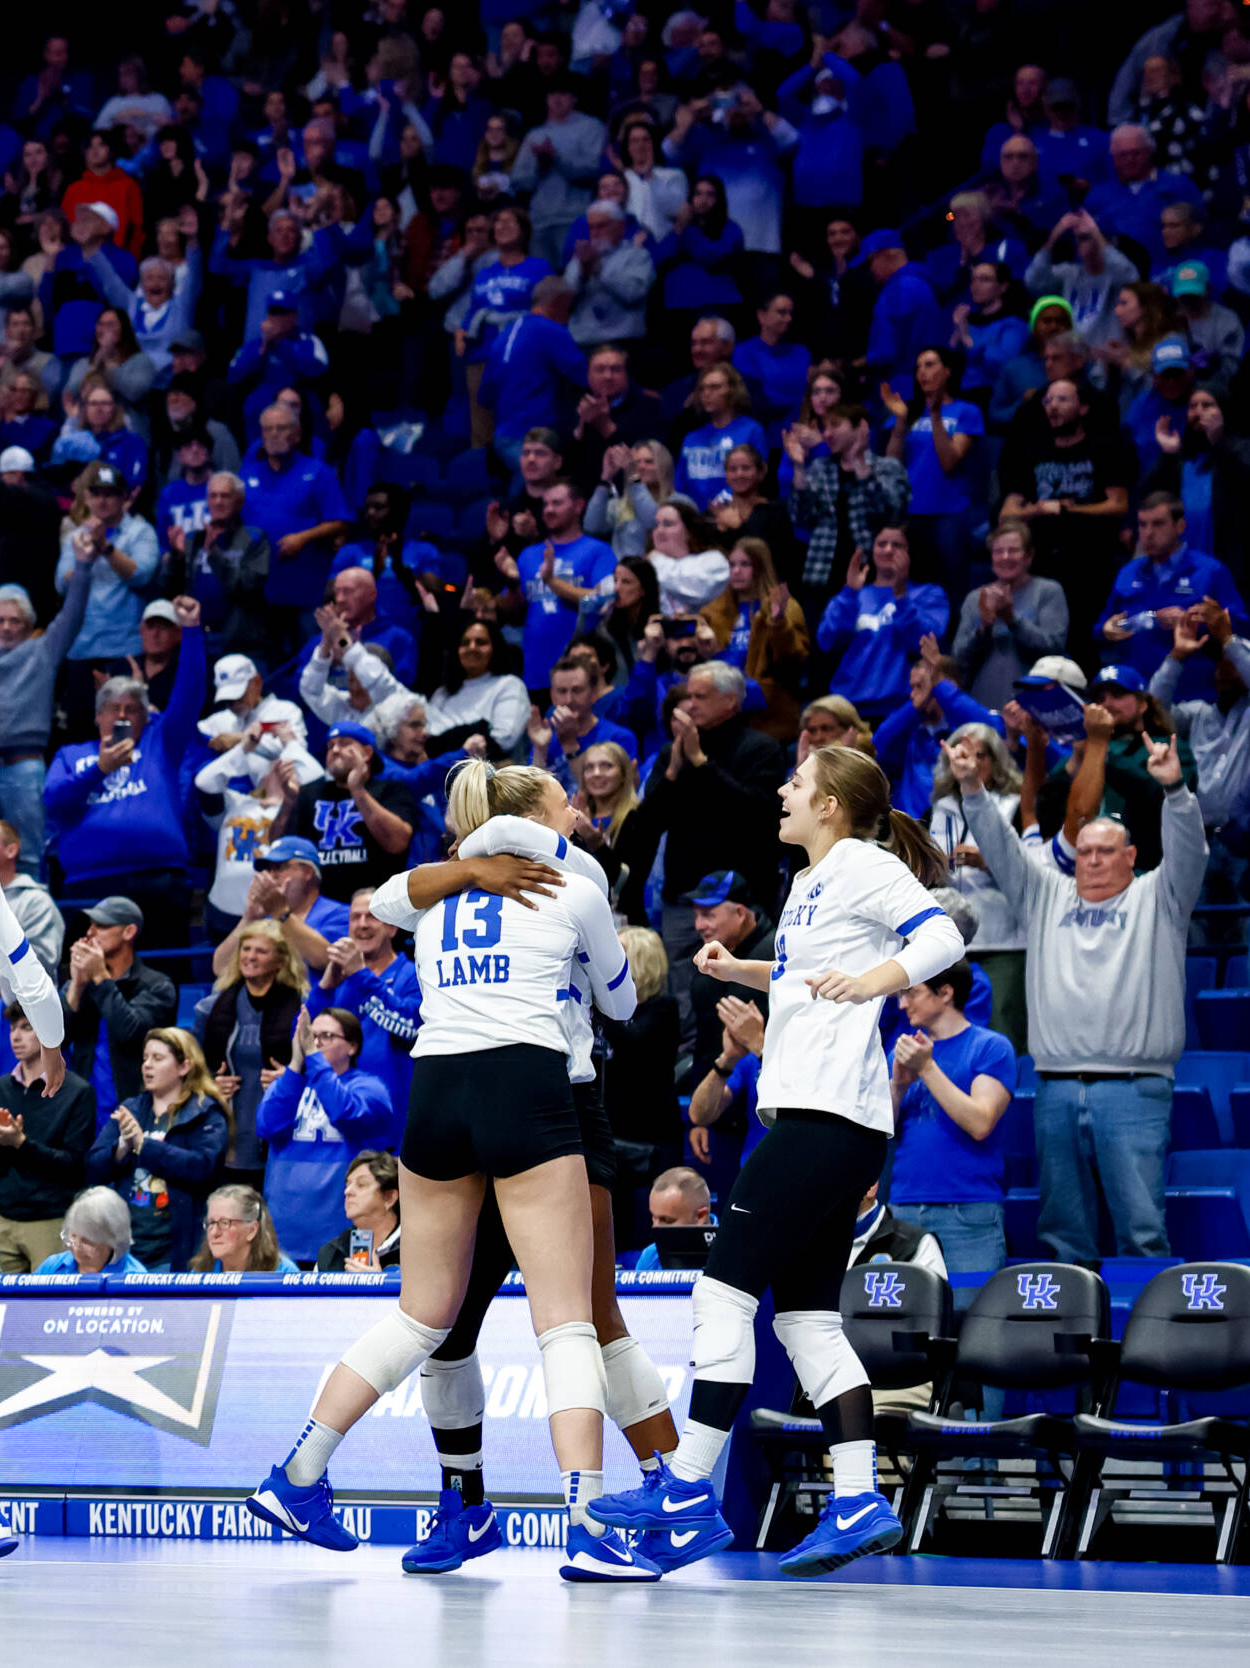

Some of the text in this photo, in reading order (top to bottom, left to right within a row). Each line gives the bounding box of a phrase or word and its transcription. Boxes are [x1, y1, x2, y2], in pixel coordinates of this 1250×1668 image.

[312, 798, 364, 849] UK
[441, 888, 504, 953] 13
[436, 954, 511, 988] LAMB
[17, 1273, 82, 1286] COMMITMENT
[124, 1273, 243, 1285] KENTUCKY FARM BUREAU
[282, 1273, 388, 1286] BIG ON COMMITMENT
[637, 1271, 703, 1284] COMMITME
[863, 1271, 906, 1308] UK
[1017, 1273, 1062, 1310] UK
[1181, 1273, 1227, 1310] UK
[43, 1318, 69, 1334] ON
[68, 1306, 143, 1317] POWERED BY
[88, 1503, 205, 1536] KENTUCKY
